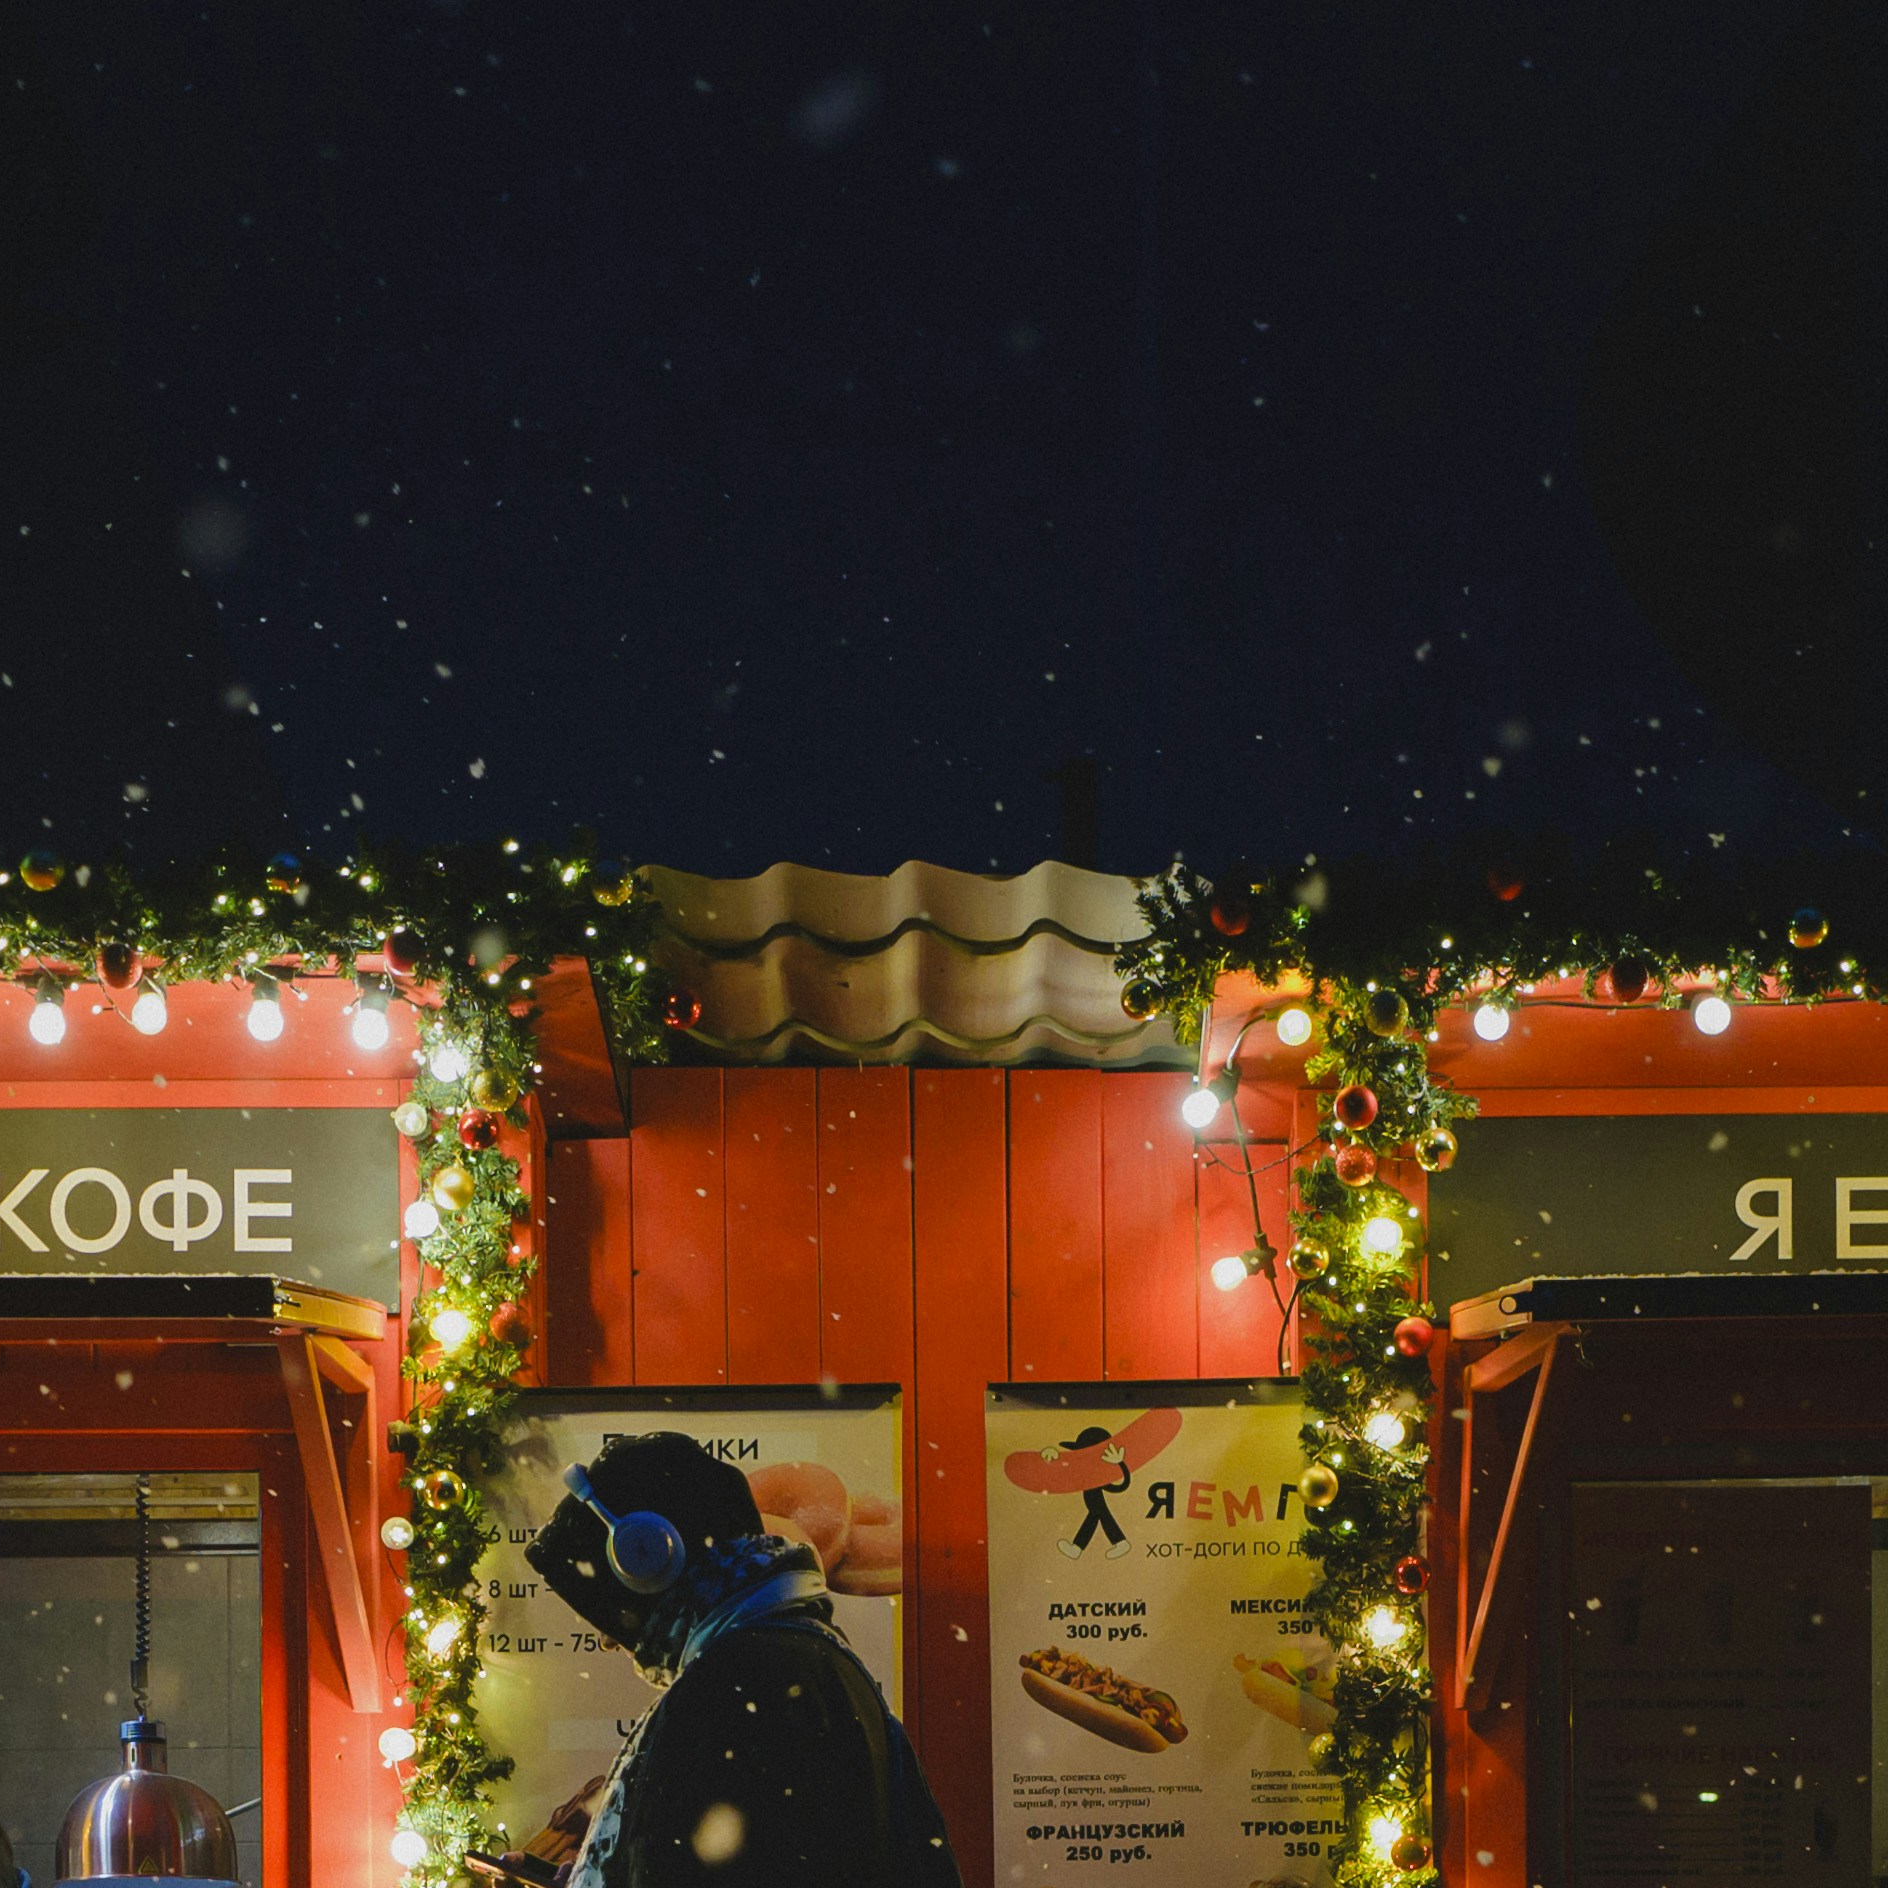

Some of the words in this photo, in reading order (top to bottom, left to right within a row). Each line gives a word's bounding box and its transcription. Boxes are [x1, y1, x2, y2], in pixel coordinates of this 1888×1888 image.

[1728, 1176, 1794, 1261] Я
[1146, 1541, 1246, 1560] ХОТ-ДОГИ
[1253, 1541, 1281, 1556] ПО
[488, 1579, 501, 1599] 8
[508, 1582, 539, 1599] шт
[1048, 1598, 1147, 1621] ДАТСКИЙ
[1066, 1624, 1102, 1639] 300
[1108, 1624, 1148, 1641] руб.
[1277, 1620, 1313, 1635] 350
[489, 1633, 511, 1653] 12
[517, 1636, 548, 1653] шт
[1025, 1819, 1186, 1842] ФРАНЦУЗСКИЙ
[1240, 1820, 1350, 1837] ТРЮФЕЛЬ
[1065, 1845, 1103, 1861] 250
[1109, 1845, 1152, 1863] руб.
[1283, 1841, 1321, 1857] 350
